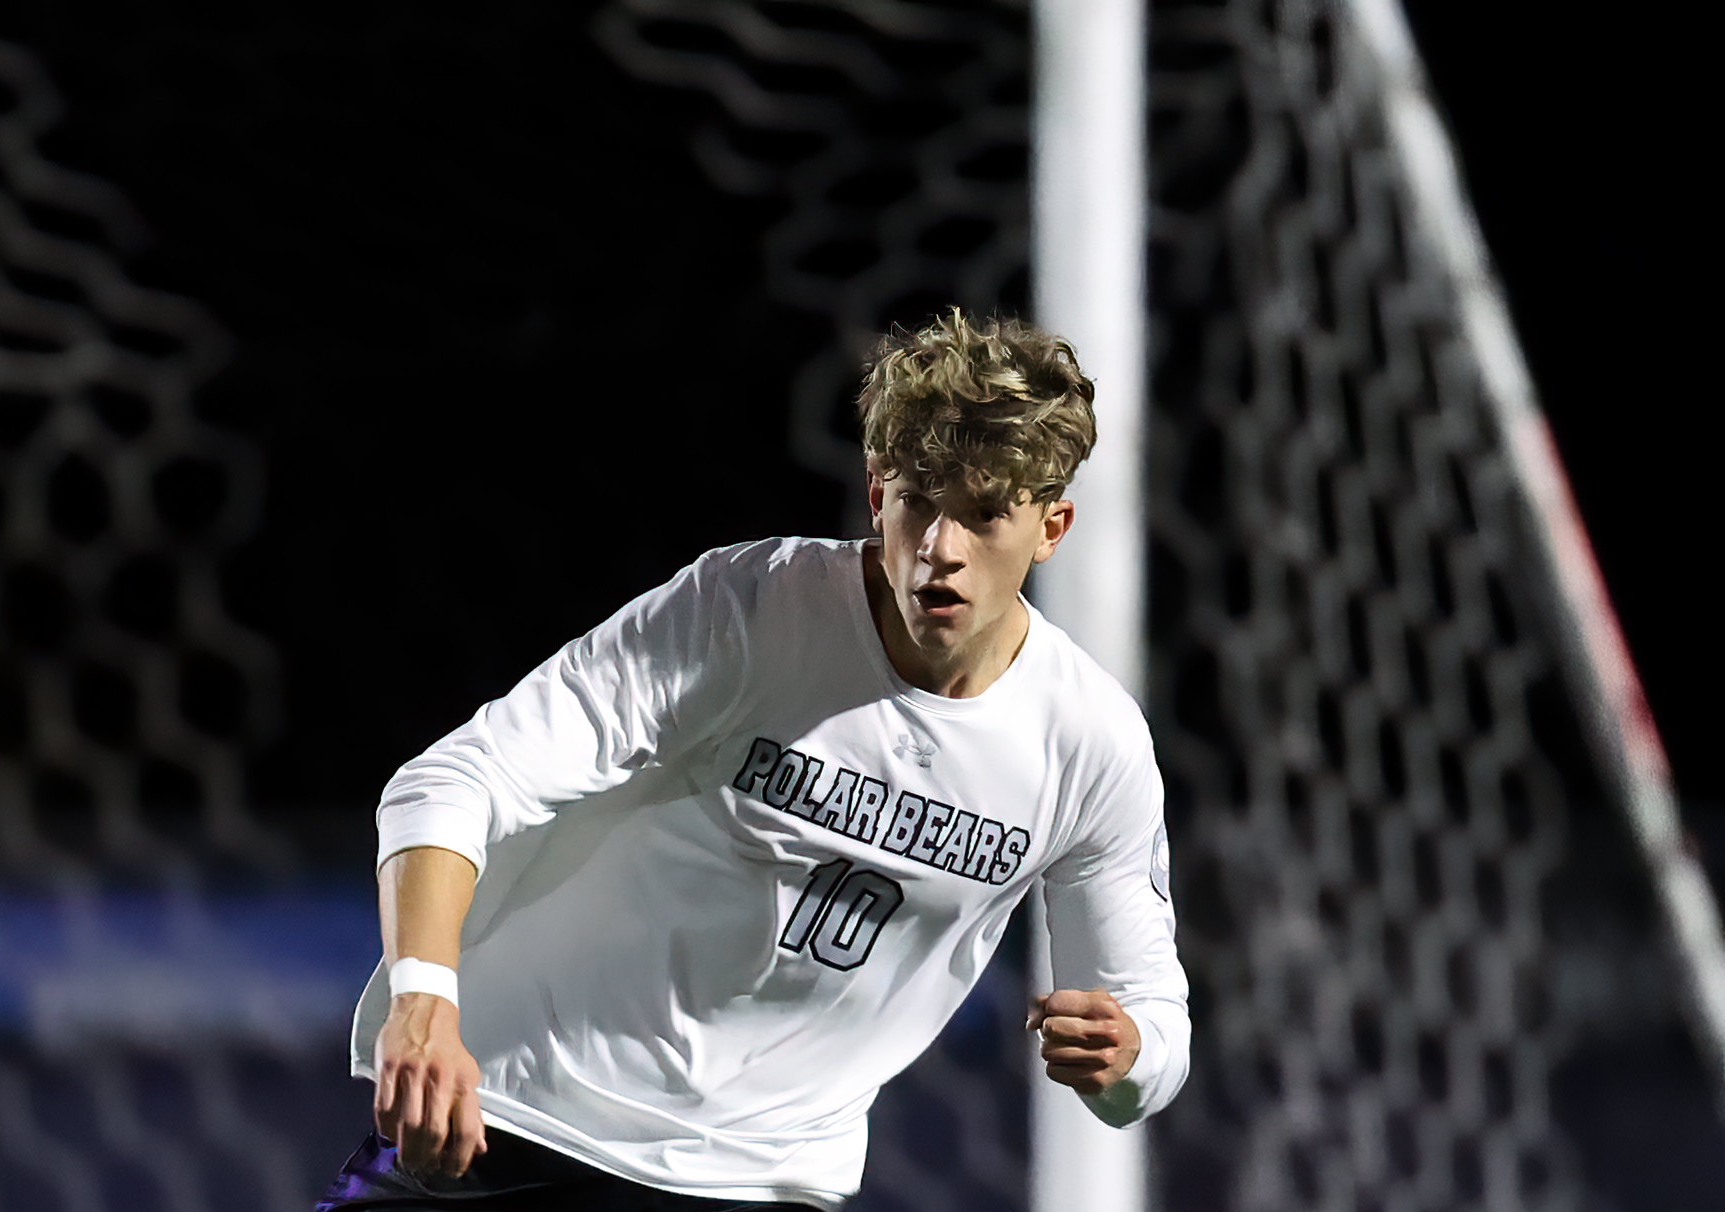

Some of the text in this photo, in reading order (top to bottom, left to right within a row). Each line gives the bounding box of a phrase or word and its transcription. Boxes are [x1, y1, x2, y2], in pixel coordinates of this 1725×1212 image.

[733, 737, 1031, 886] POLAR BEARS
[778, 858, 905, 972] 10
